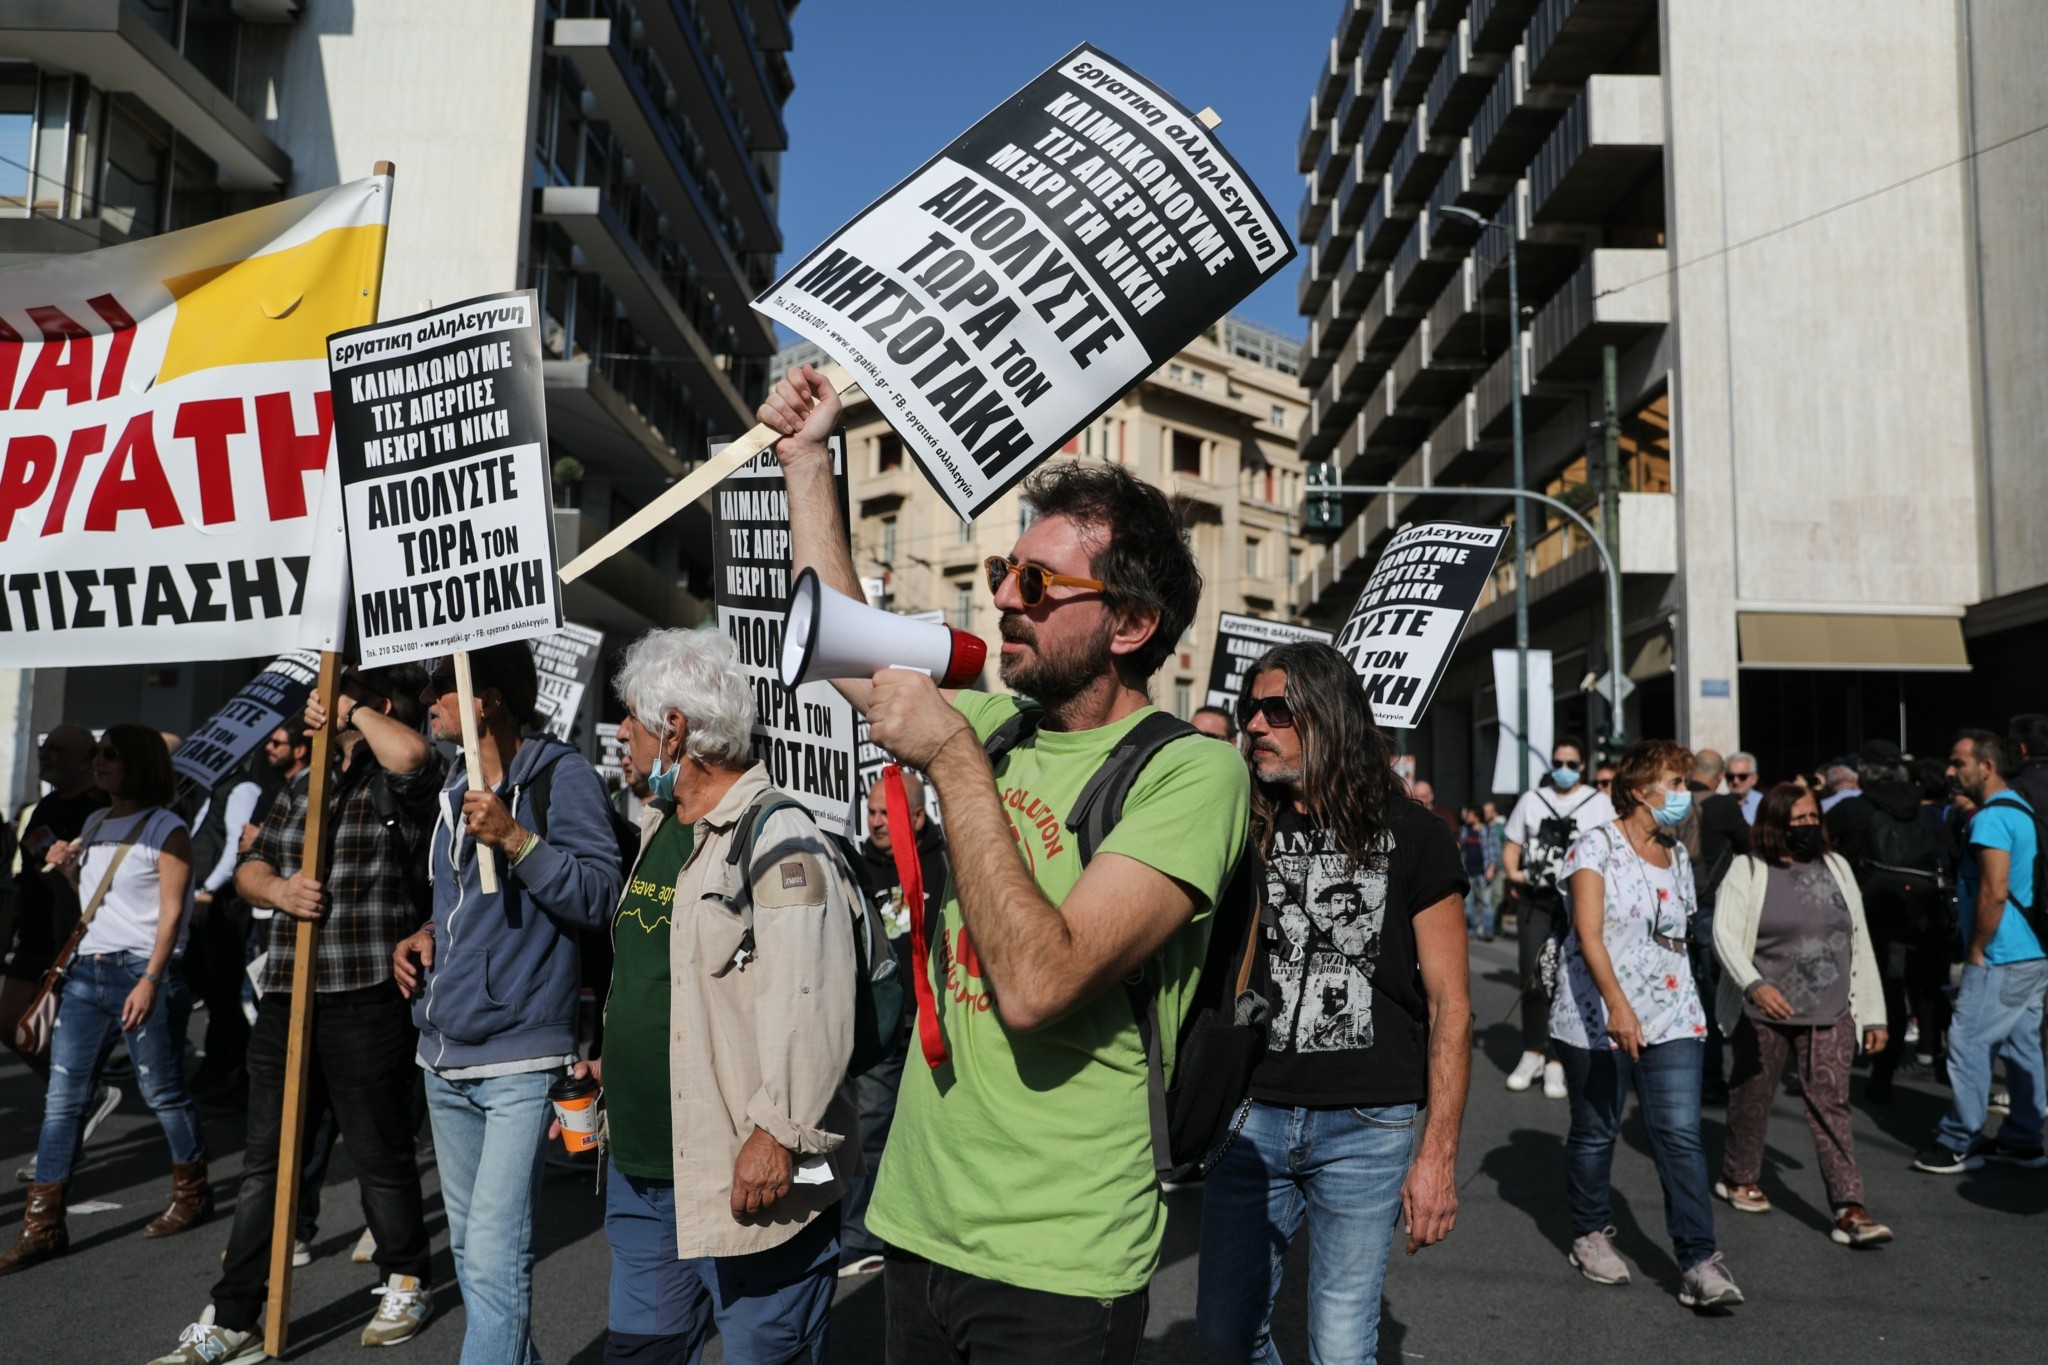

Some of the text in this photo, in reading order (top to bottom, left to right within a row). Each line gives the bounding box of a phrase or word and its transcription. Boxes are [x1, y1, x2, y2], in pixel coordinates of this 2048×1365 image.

[1043, 91, 1235, 276] ΚΛΙΜΑΚΩΝΟΥΜΕ
[1072, 62, 1276, 262] εργατικη αλληλεγγυη
[986, 143, 1166, 317] ΜΕΧΡΙ ΤΗ ΝΙΚΗ
[1033, 126, 1188, 277] ΤΙΣ ΑΠΕΡΓΙΕΣ
[918, 175, 1126, 370] ΑΠΟΛΥΣΤΕ
[335, 305, 525, 364] εργατικη αλληλεγγυη
[896, 231, 1053, 408] ΤΩΡΑ ΤΟΝ
[350, 341, 513, 404] ΚΛΙΜΑΚΩΝΟΥΜΕ
[785, 303, 801, 315] 210
[797, 309, 829, 332] 5241001
[829, 330, 890, 390] www.ergatiki.gr
[891, 393, 907, 411] FB:
[904, 410, 940, 448] εργατική
[793, 247, 1034, 481] ΜΗΤΣΟΤΑΚΗ
[371, 378, 496, 433] ΤΙΣ ΑΠΕΡΓΙΕΣ
[363, 409, 510, 468] ΜΕΧΡΙ ΤΗ ΝΙΚΗ
[368, 454, 518, 530] ΑΠΟΛΥΣΤΕ
[720, 490, 789, 521] ΚΛΙΜΑΚΩΝ
[397, 519, 519, 577] ΤΩΡΑ ΤΟΝ
[730, 529, 793, 561] ΤΙΣ ΑΠΕΡ
[361, 558, 546, 638] ΜΗΤΣΟΤΑΚΗ
[726, 565, 787, 599] ΜΕΧΡΙ ΤΗ
[1357, 582, 1444, 612] ΤΗ ΝΙΚΗ
[379, 646, 391, 656] 210
[392, 642, 418, 654] 5241001
[424, 632, 471, 649] www.ergatiki.gr
[729, 614, 784, 670] ΑΠΟΛ
[1361, 650, 1409, 669] ΤΟΝ
[804, 702, 832, 739] ΤΟΝ
